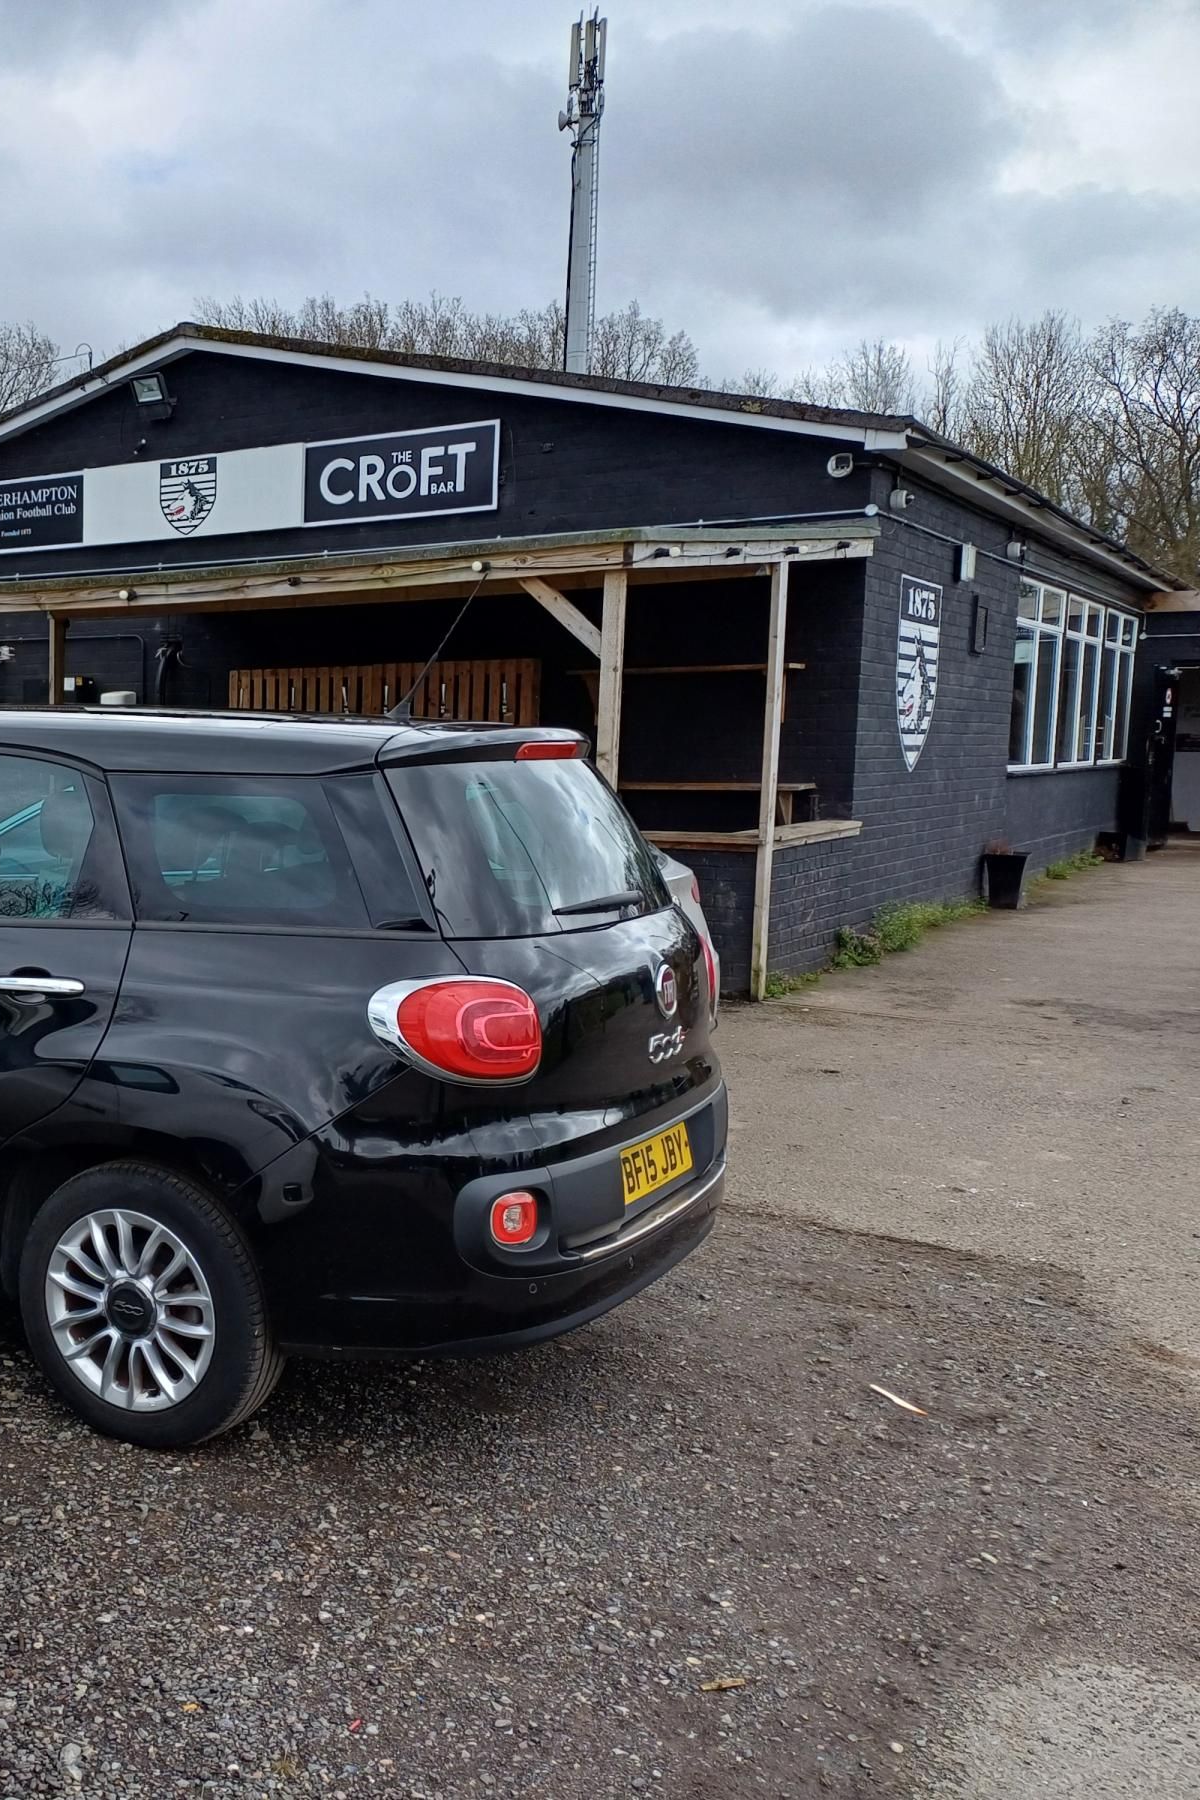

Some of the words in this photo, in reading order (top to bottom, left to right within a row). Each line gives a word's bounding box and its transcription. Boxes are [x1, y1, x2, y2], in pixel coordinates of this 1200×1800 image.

[392, 450, 412, 464] THE
[170, 460, 209, 476] 1875
[320, 442, 477, 505] CROFT
[430, 481, 455, 495] BAR
[16, 503, 52, 519] Football
[54, 502, 77, 515] Club
[907, 586, 936, 621] 1875
[621, 1144, 658, 1195] BF15
[660, 1129, 684, 1175] JBY
